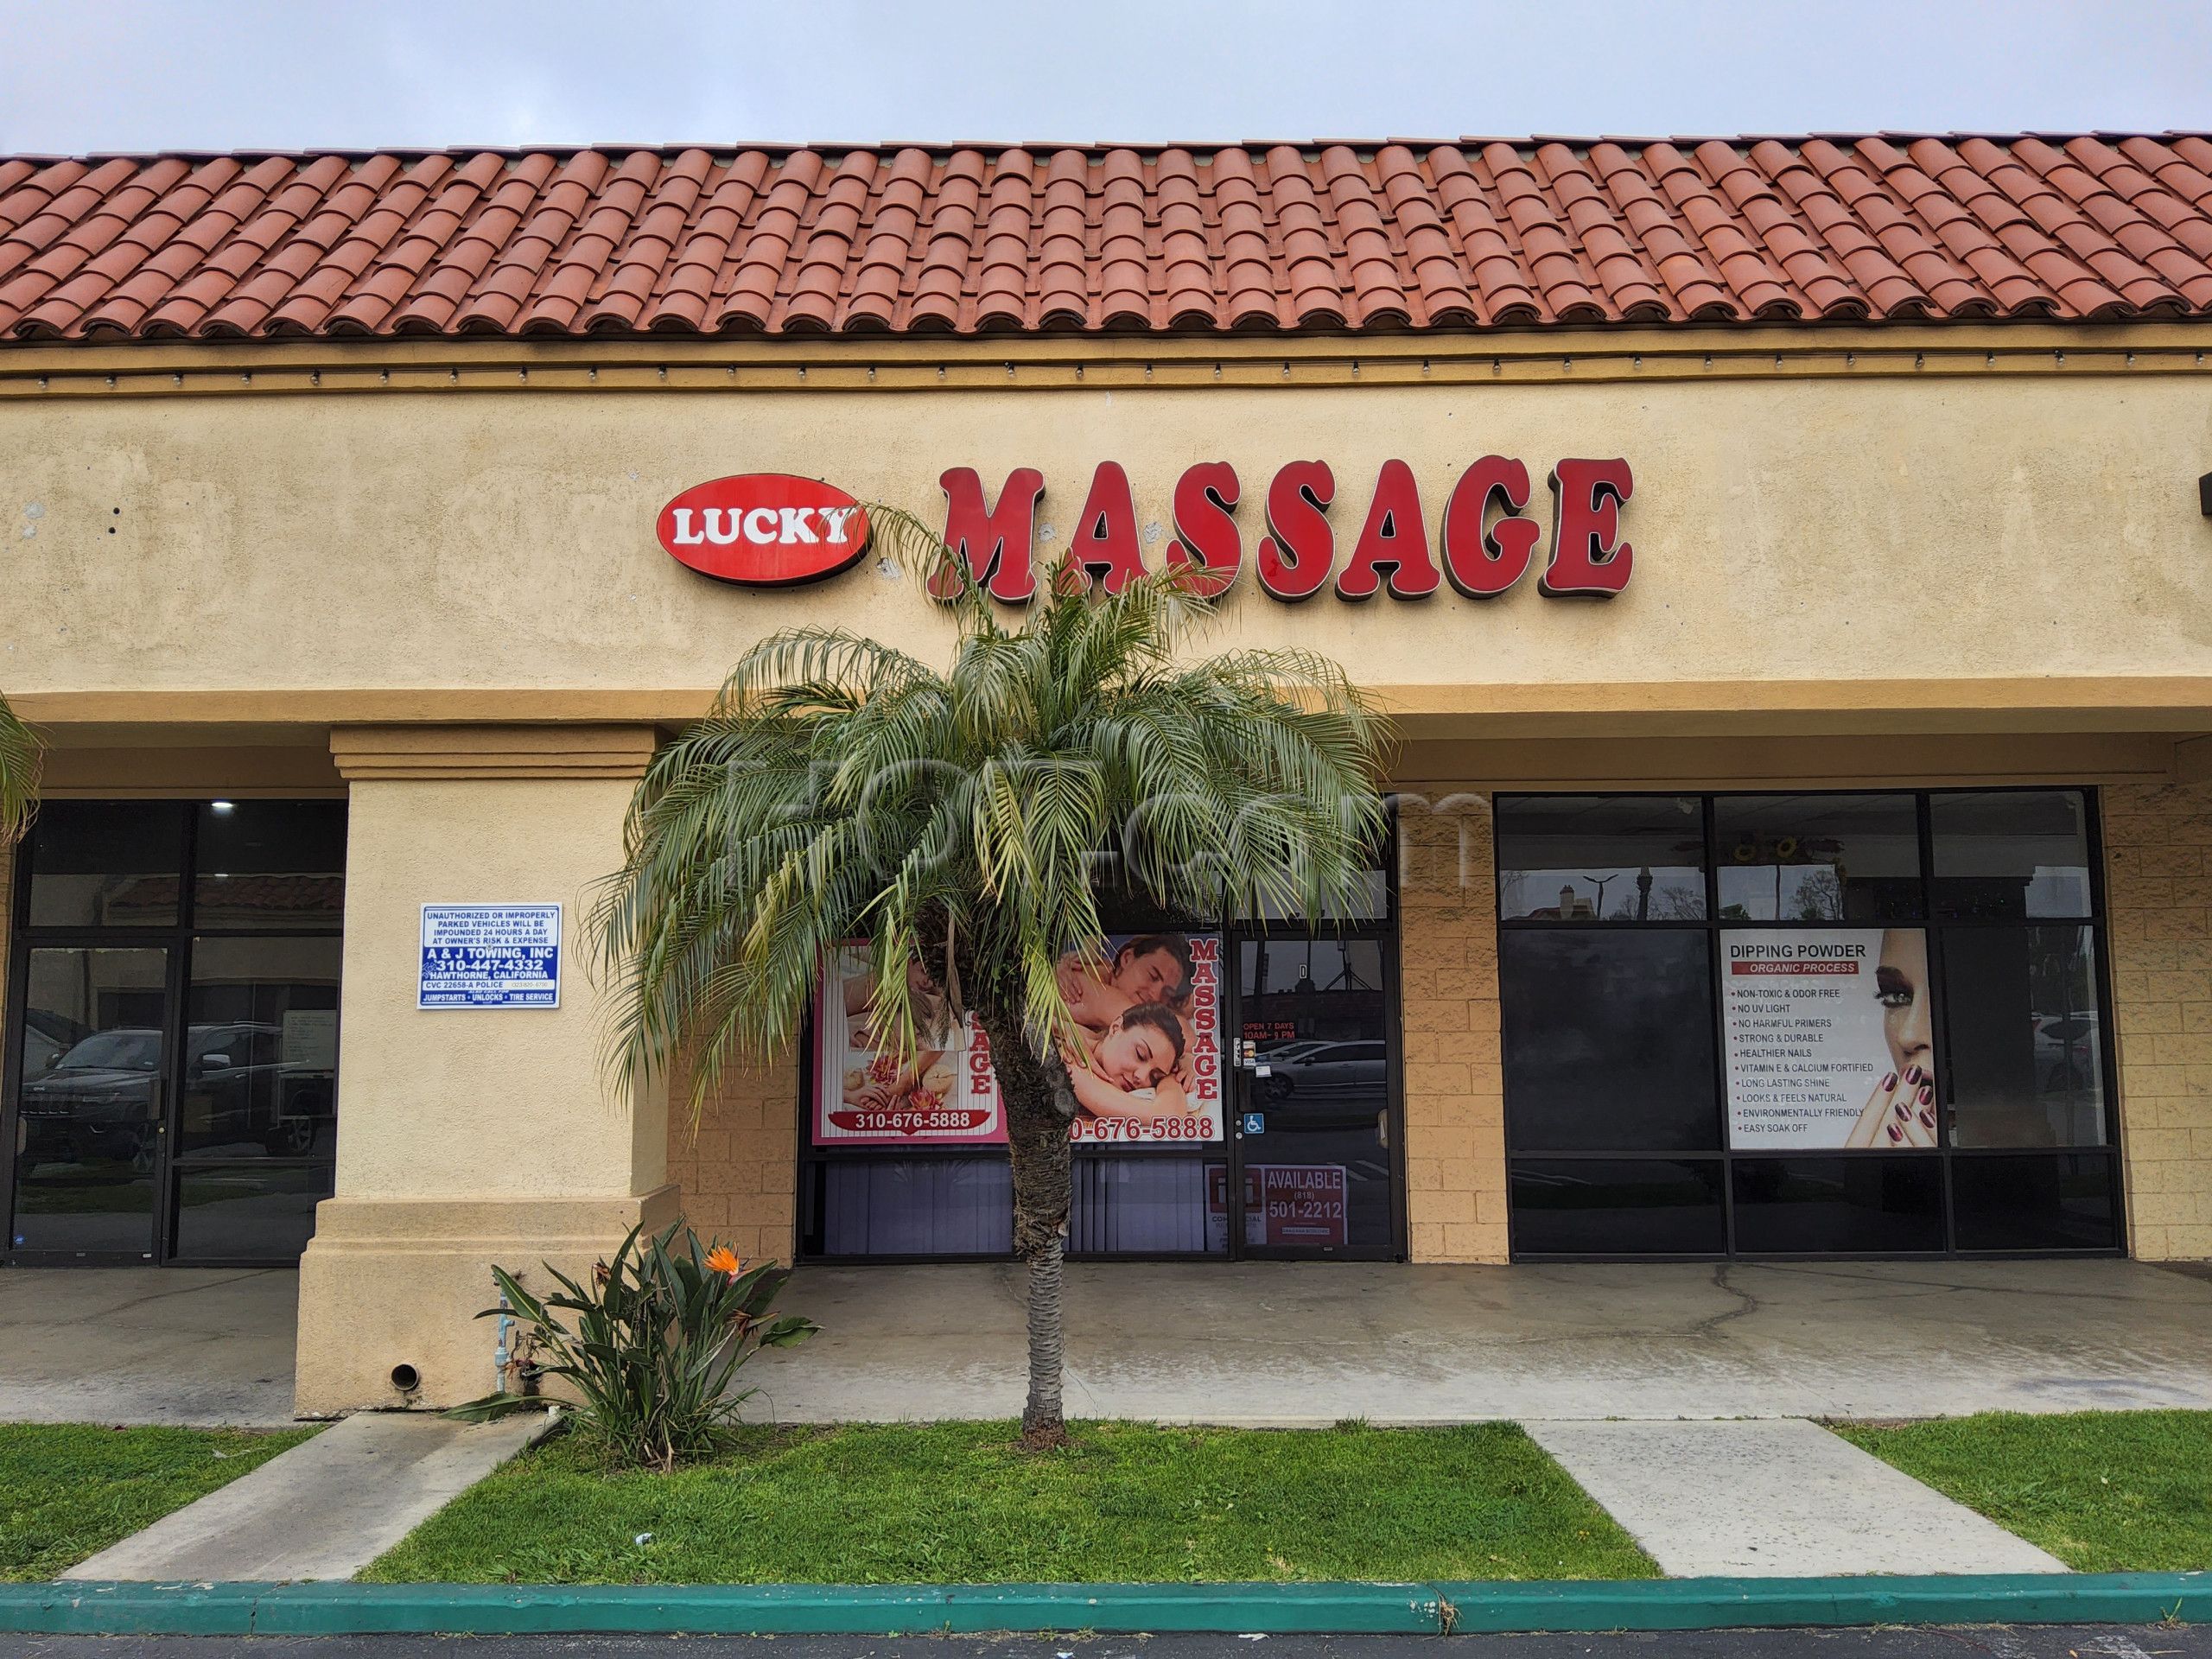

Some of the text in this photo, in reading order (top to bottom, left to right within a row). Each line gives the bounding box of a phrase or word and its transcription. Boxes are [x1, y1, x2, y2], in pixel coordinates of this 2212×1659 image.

[672, 507, 856, 545] LUCKY
[927, 454, 1632, 604] MASSAGE
[427, 947, 554, 960] A & J TOWING, INC
[1730, 944, 1866, 958] DIPPING POWDER
[436, 959, 543, 971] 310-447-4332
[1750, 963, 1855, 973] ORGANIC PROCESS
[429, 970, 549, 980] HAWTHORNE, CALIFORNIA
[1737, 988, 1840, 998] NON-TOXIC & ODOR FREE
[1738, 1004, 1790, 1013] NO UV LIGHT
[1190, 939, 1218, 1101] MASSAGE
[1795, 1019, 1832, 1027] PRIMERS
[1738, 1033, 1824, 1043] STRONG & DURABLE
[1739, 1048, 1812, 1058] HEALTHIER NAILS
[1740, 1063, 1873, 1072] VITAMIN E & CALCIUM FORTIFIED
[1741, 1078, 1830, 1088] LONG LASTING SHINE
[1742, 1093, 1847, 1103] LOOKS & FEELS NATURAL
[1743, 1108, 1865, 1117] ENVIRONMENTALLY FRIENDLY
[855, 1112, 970, 1128] 310-676-5888
[1071, 1116, 1214, 1141] 0-676-5888
[1744, 1124, 1808, 1133] EASY SOAK OFF
[1267, 1171, 1341, 1189] AVAILABLE
[1294, 1191, 1315, 1201] (818)
[1269, 1201, 1342, 1218] 501-2212
